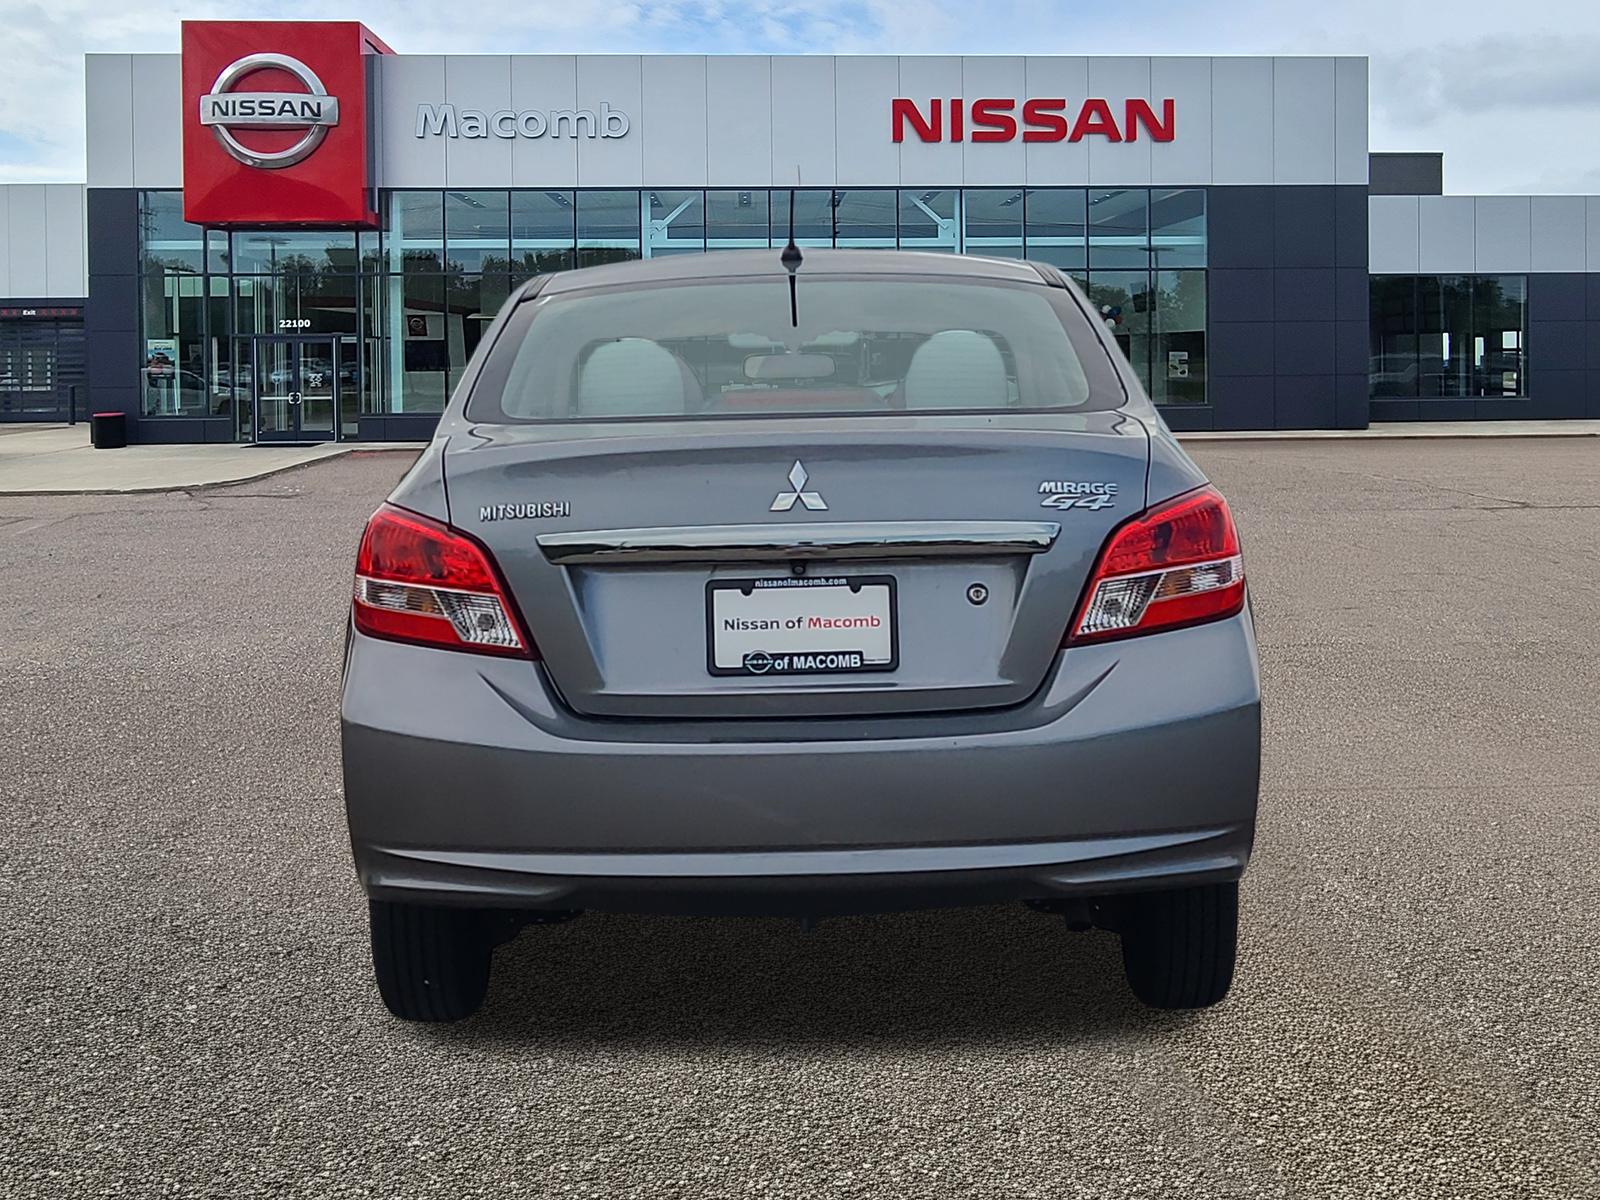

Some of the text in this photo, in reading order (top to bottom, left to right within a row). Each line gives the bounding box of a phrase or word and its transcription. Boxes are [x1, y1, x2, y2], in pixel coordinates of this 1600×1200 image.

[211, 98, 323, 118] NISSAN
[414, 101, 631, 139] Macomb
[891, 98, 1176, 143] NISSAN
[279, 319, 311, 328] 22100
[1038, 481, 1119, 495] MIRAGE
[1040, 493, 1116, 511] G4
[479, 501, 571, 522] MITSUBISHI
[754, 577, 848, 588] nissanofmacomb.com
[723, 615, 881, 631] Nissan of Macomb
[774, 656, 790, 670] of
[793, 654, 861, 670] MACOMB
